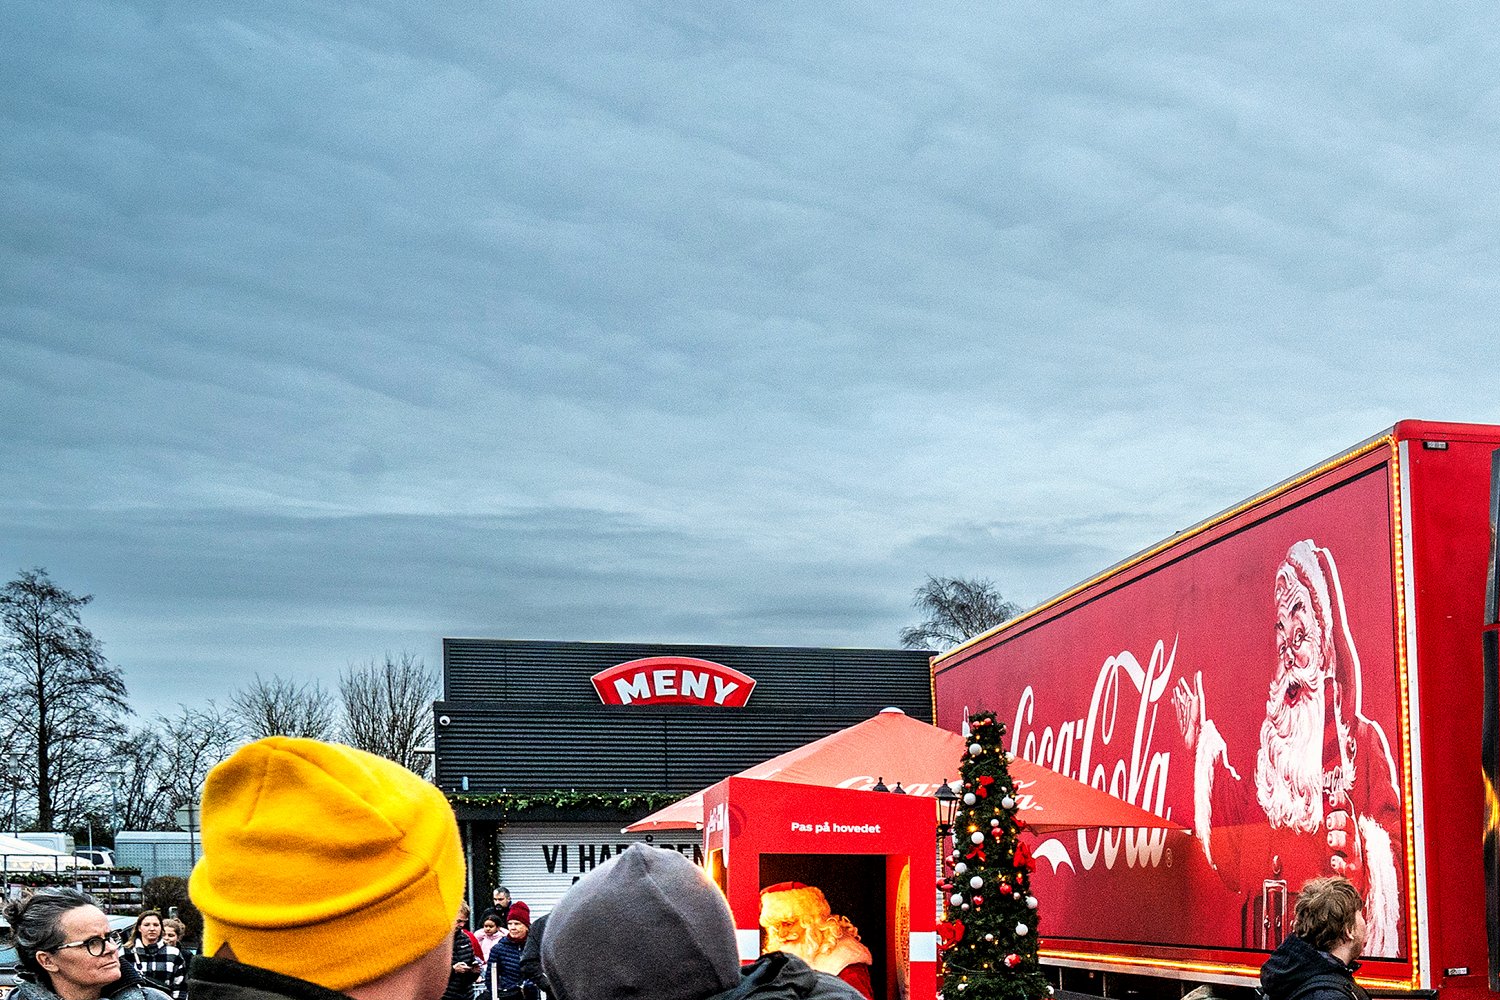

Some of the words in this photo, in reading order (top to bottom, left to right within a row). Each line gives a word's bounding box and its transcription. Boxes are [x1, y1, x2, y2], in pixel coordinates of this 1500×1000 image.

[613, 669, 739, 705] MENY
[791, 821, 813, 832] Pas
[815, 821, 830, 834] på
[832, 823, 881, 834] hovedet
[542, 844, 568, 873] VI
